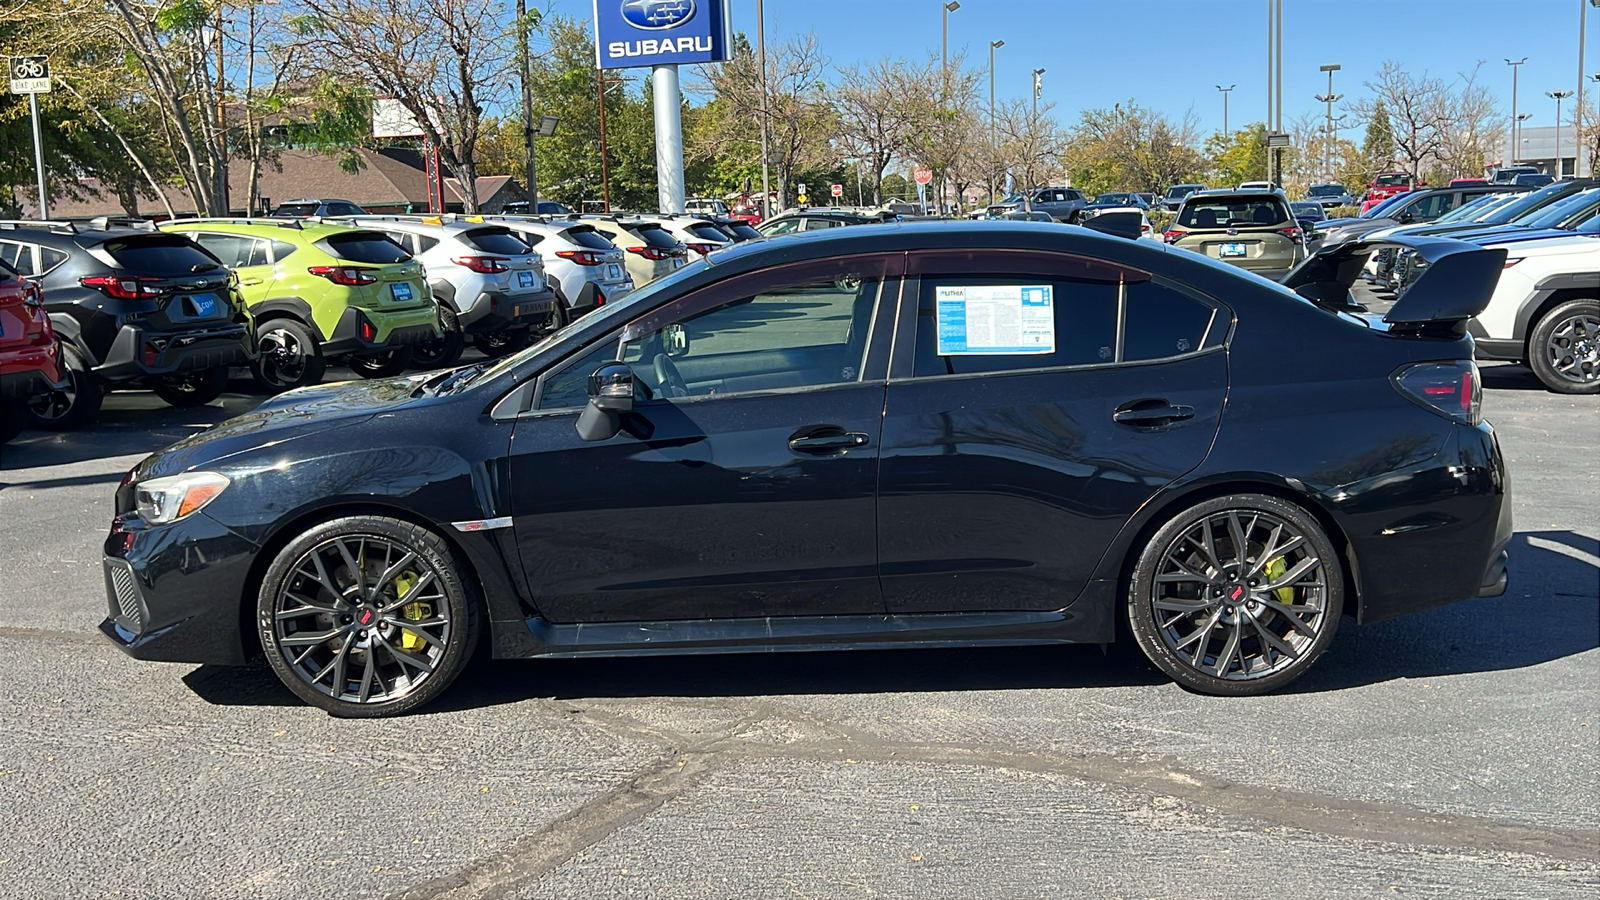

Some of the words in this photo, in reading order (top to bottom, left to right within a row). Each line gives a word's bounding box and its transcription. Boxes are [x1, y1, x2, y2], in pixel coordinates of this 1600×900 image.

[608, 36, 712, 58] SUBARU
[15, 82, 29, 90] BIKE
[32, 81, 47, 89] LANE
[915, 170, 932, 179] STOP
